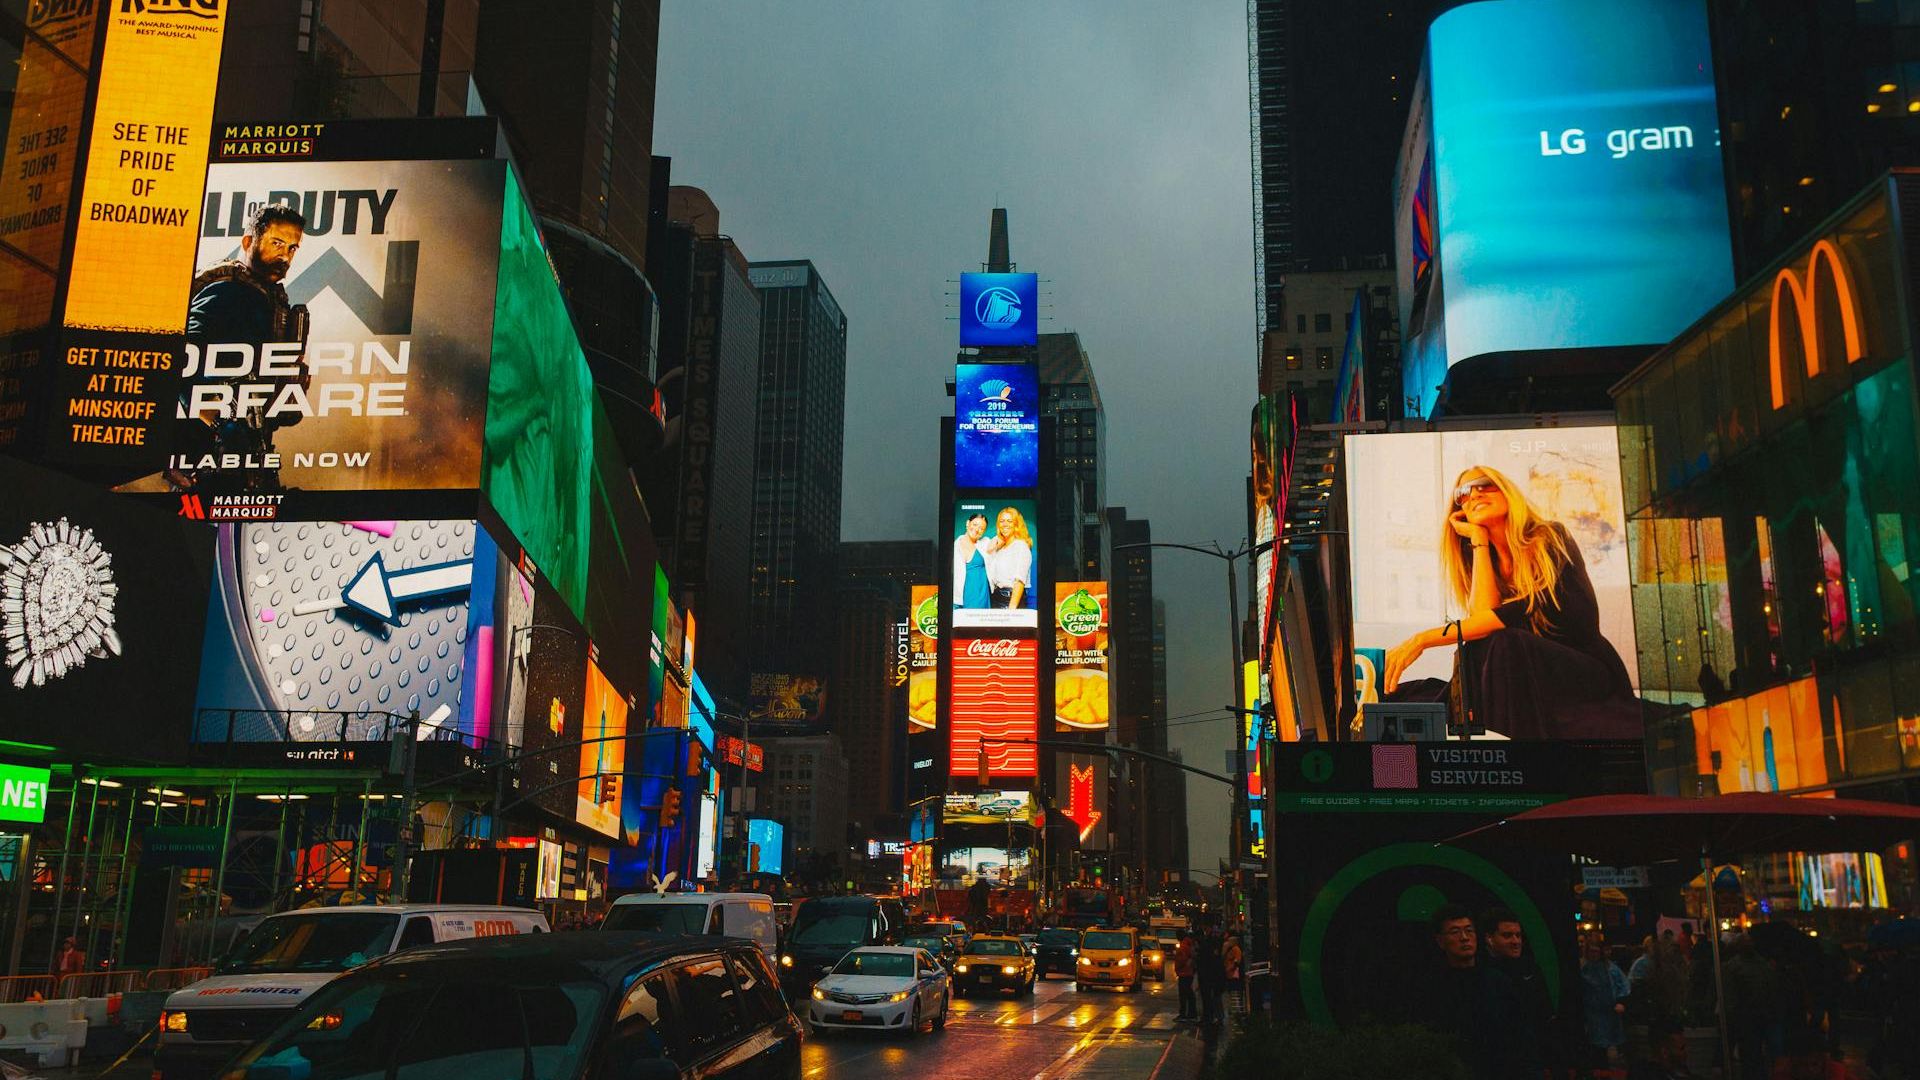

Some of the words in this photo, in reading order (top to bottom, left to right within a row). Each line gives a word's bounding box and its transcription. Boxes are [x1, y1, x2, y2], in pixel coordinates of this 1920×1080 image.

[118, 18, 136, 27] THE
[137, 20, 219, 34] AWARD-WINNING
[136, 28, 155, 36] BEST
[156, 30, 197, 40] MUSICAL
[113, 122, 148, 142] SEE
[155, 125, 190, 146] THE
[225, 124, 325, 138] MARRIOTT
[223, 141, 311, 155] MARQUIS
[1540, 128, 1587, 156] LG
[1607, 125, 1694, 159] gram
[119, 150, 177, 172] PRIDE
[131, 178, 156, 197] OF
[90, 202, 189, 227] BROADWAY
[66, 347, 99, 366] GET
[103, 349, 173, 371] TICKETS
[87, 374, 110, 393] AT
[113, 375, 144, 394] THE
[69, 398, 156, 420] MINSKOFF
[988, 402, 1007, 411] 2019
[72, 424, 146, 446] THEATRE
[1510, 440, 1546, 453] SJP
[294, 452, 371, 468] NOW
[213, 495, 284, 505] MARRIOTT
[212, 508, 274, 518] MARQUIS
[1063, 612, 1100, 623] Green
[1068, 621, 1100, 633] Giant
[896, 617, 909, 687] NOVOTEL
[967, 638, 1020, 657] Coca-Cola
[1055, 656, 1106, 664] CAULIFLOWER
[1429, 749, 1508, 764] VISITOR
[1430, 770, 1524, 785] SERVICES
[1369, 798, 1393, 806] FREE
[1428, 799, 1470, 807] TICKETS
[1478, 799, 1544, 807] INFORMATION
[199, 987, 302, 996] ROTO-ROOTER
